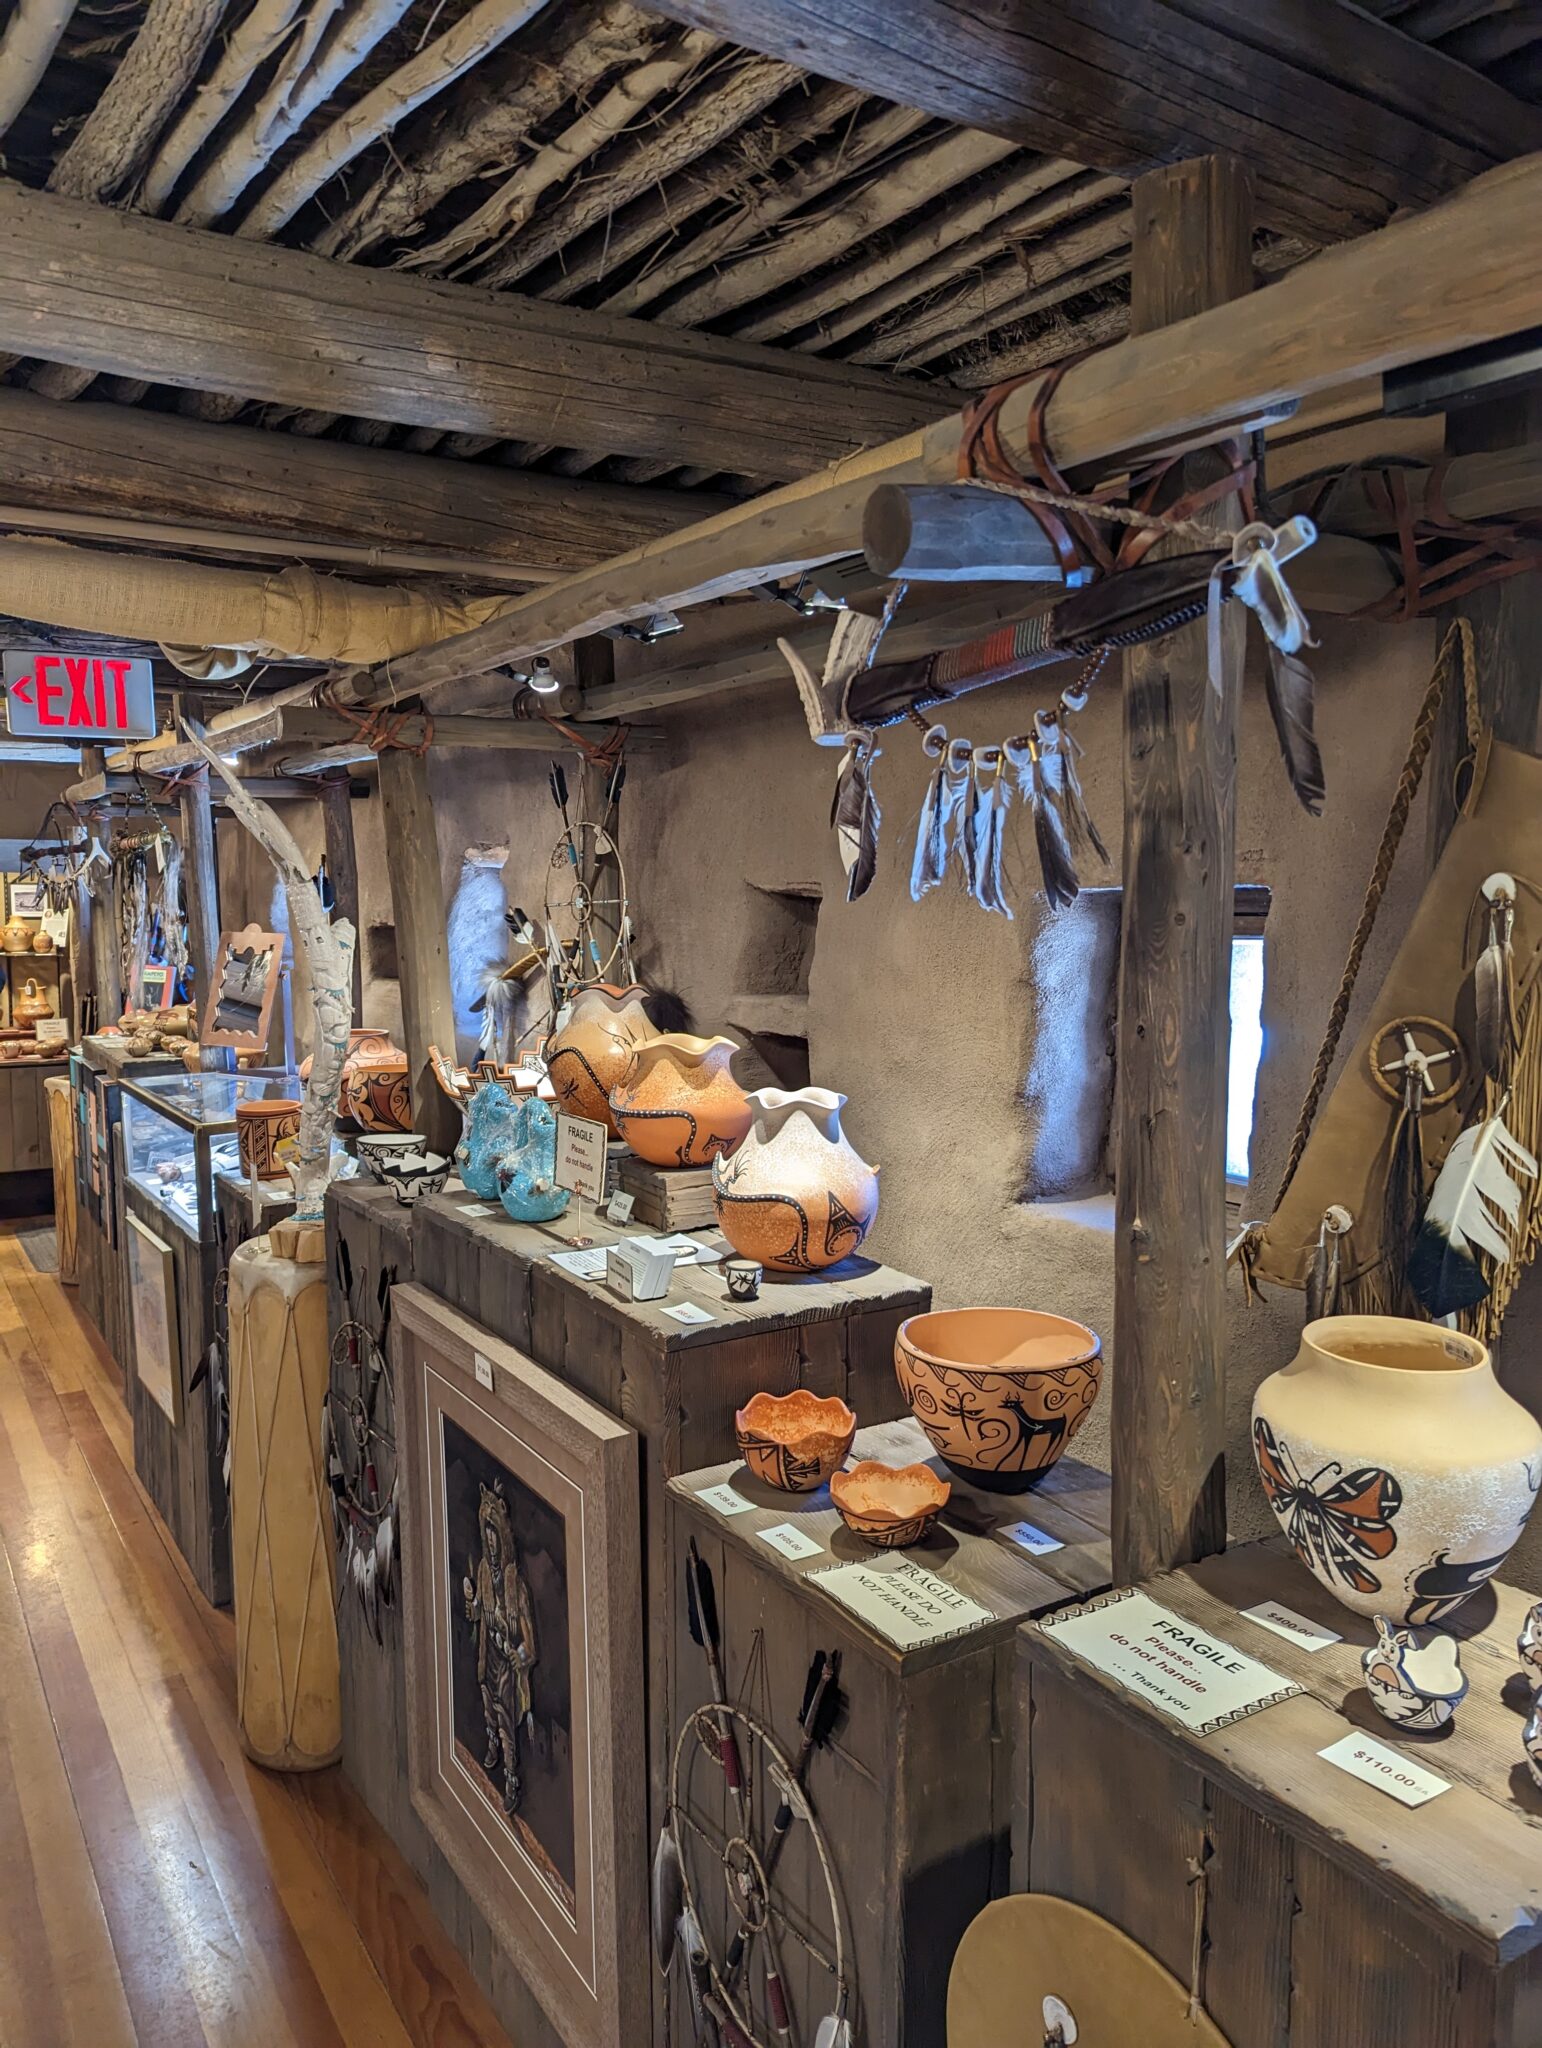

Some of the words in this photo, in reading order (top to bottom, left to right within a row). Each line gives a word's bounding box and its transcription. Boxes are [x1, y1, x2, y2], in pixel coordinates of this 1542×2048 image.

[33, 655, 132, 729] EXIT
[568, 1125, 594, 1143] FRAGILE
[565, 1155, 572, 1164] do
[571, 1158, 579, 1167] not
[579, 1159, 593, 1172] handle
[852, 1575, 886, 1595] NOT
[878, 1591, 933, 1629] HANDLE
[879, 1574, 923, 1602] PLEASE
[918, 1600, 943, 1615] DO
[895, 1563, 968, 1610] FRAGILE
[1267, 1612, 1315, 1638] $400.00
[1109, 1632, 1129, 1647] do
[1129, 1644, 1155, 1663] not
[1155, 1660, 1208, 1694] handle
[1144, 1636, 1203, 1675] Please...
[1152, 1619, 1246, 1675] FRAGILE
[1130, 1671, 1167, 1698] Thank
[1164, 1694, 1191, 1712] you
[1353, 1750, 1416, 1787] $110.00
